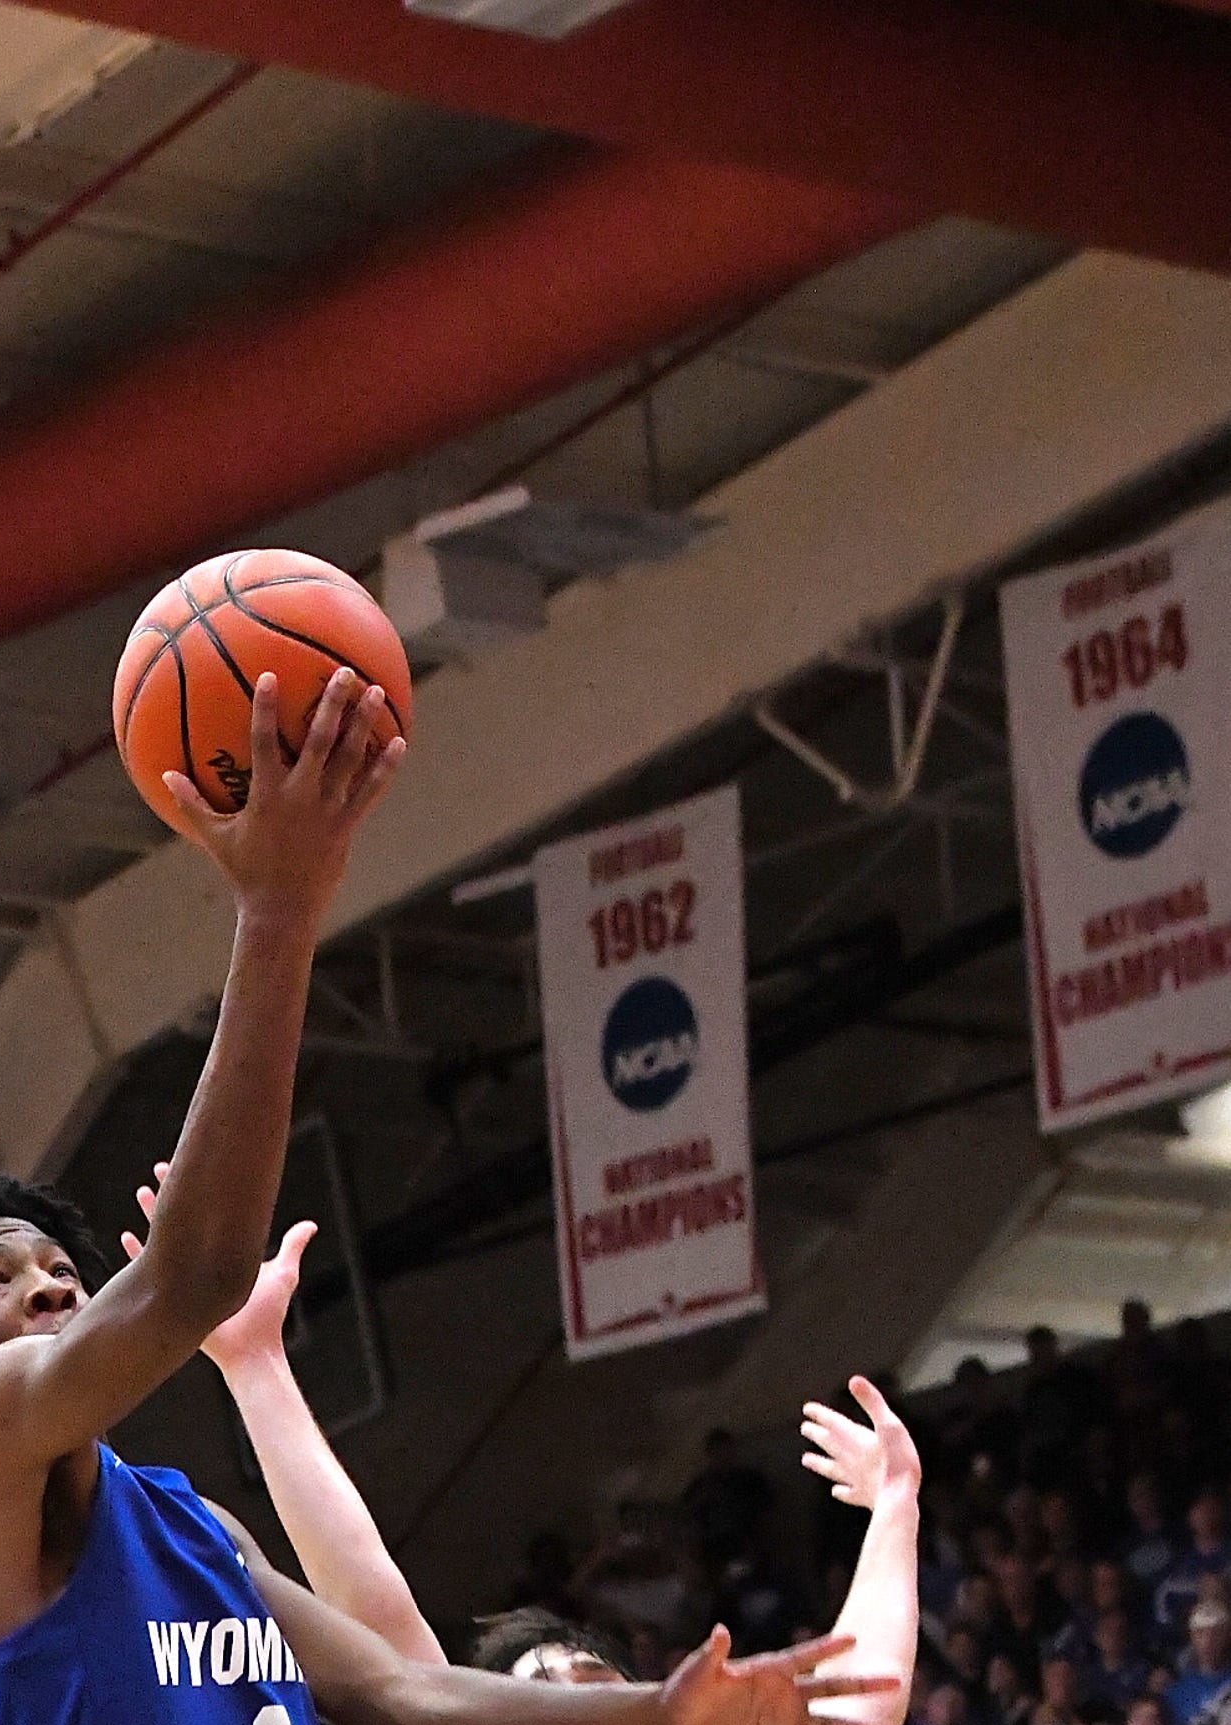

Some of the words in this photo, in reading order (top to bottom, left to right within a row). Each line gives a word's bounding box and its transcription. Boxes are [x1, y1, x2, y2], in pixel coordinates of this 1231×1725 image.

[1062, 602, 1188, 708] 1964
[587, 880, 696, 969] 1962
[1054, 921, 1231, 1027] CHAMPION
[580, 1173, 745, 1263] CHAMPIONS
[147, 1616, 304, 1687] WYOMI
